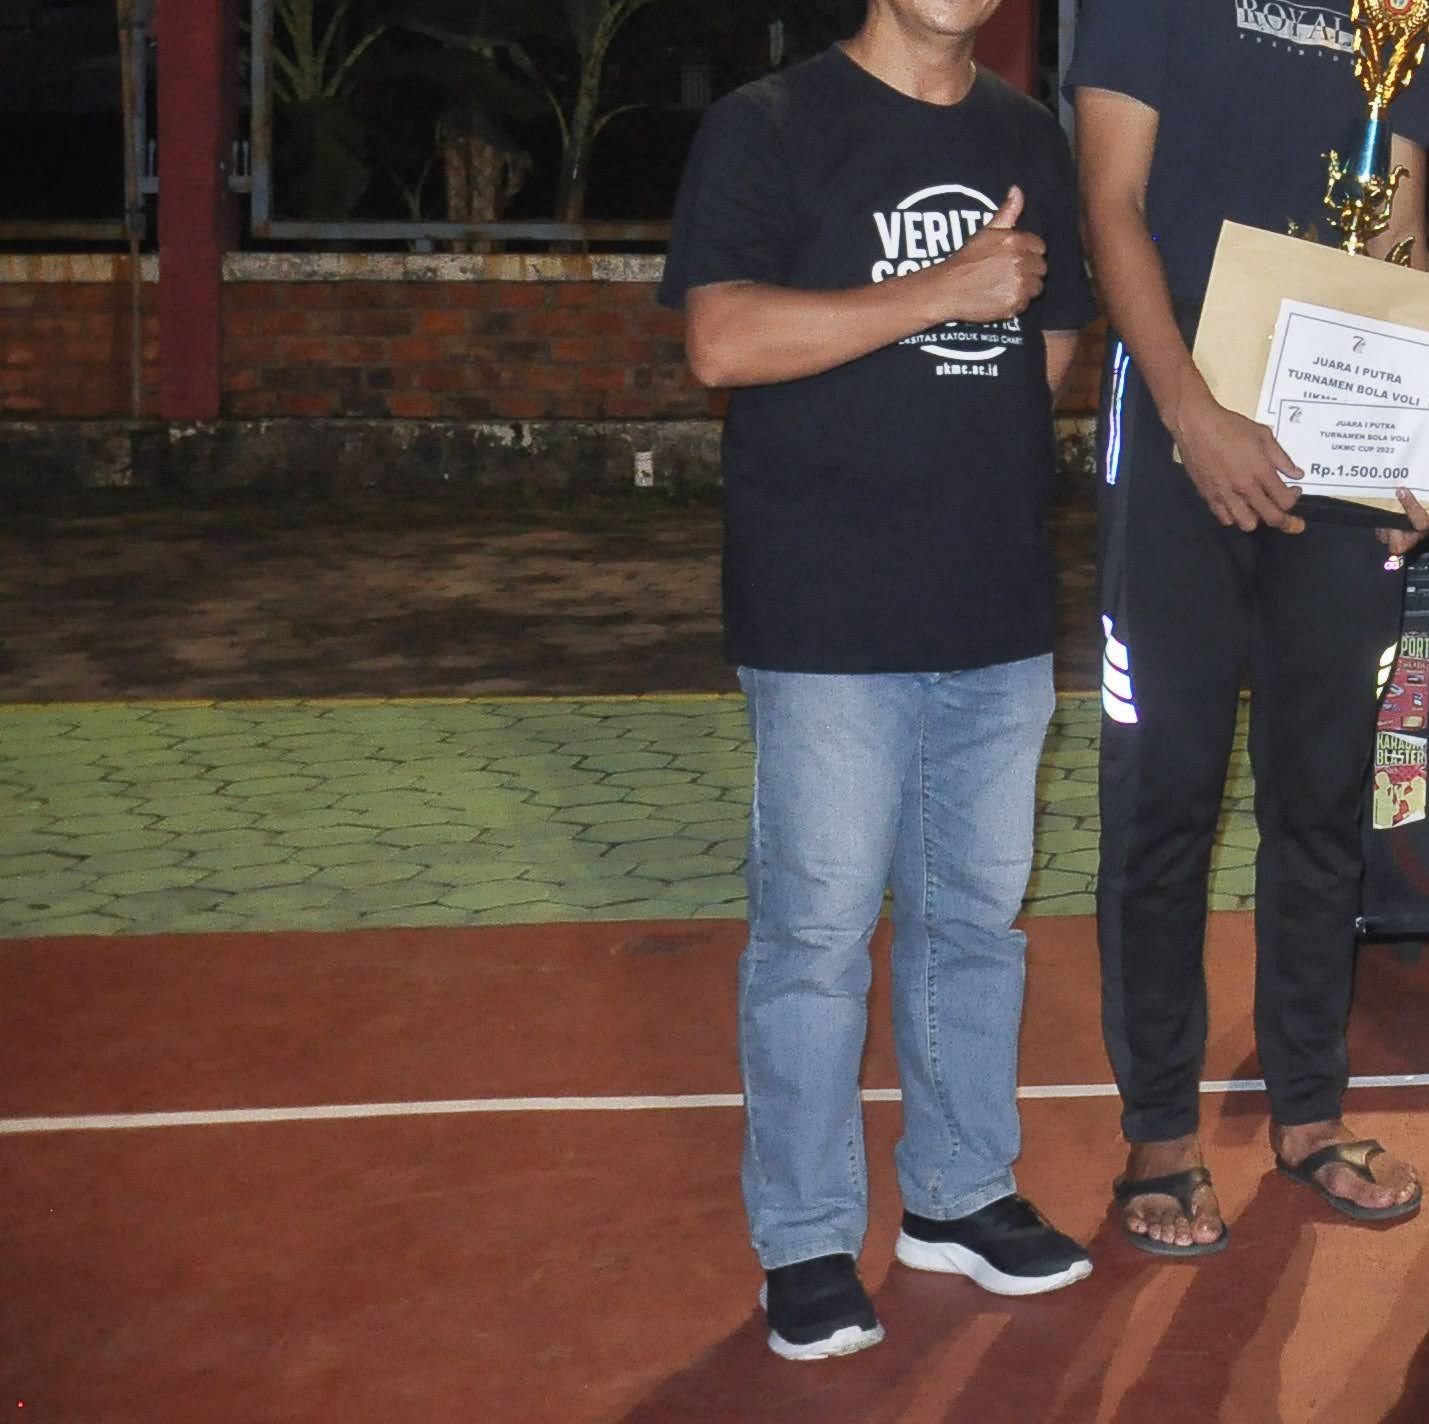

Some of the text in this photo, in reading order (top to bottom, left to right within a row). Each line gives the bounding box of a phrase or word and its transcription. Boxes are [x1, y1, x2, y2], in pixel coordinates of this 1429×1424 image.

[873, 209, 994, 259] VERIT
[1312, 356, 1403, 385] JUARA I PUTRA
[1288, 368, 1355, 392] TURNAMEN
[1356, 384, 1389, 400] BOLA
[1393, 392, 1421, 407] VOLI
[1335, 420, 1363, 429] JUARA
[1320, 431, 1366, 441] TURNAMEN
[1367, 434, 1388, 442] BOLA
[1358, 445, 1375, 453] CUP
[1310, 462, 1410, 479] Rp.1.500.000
